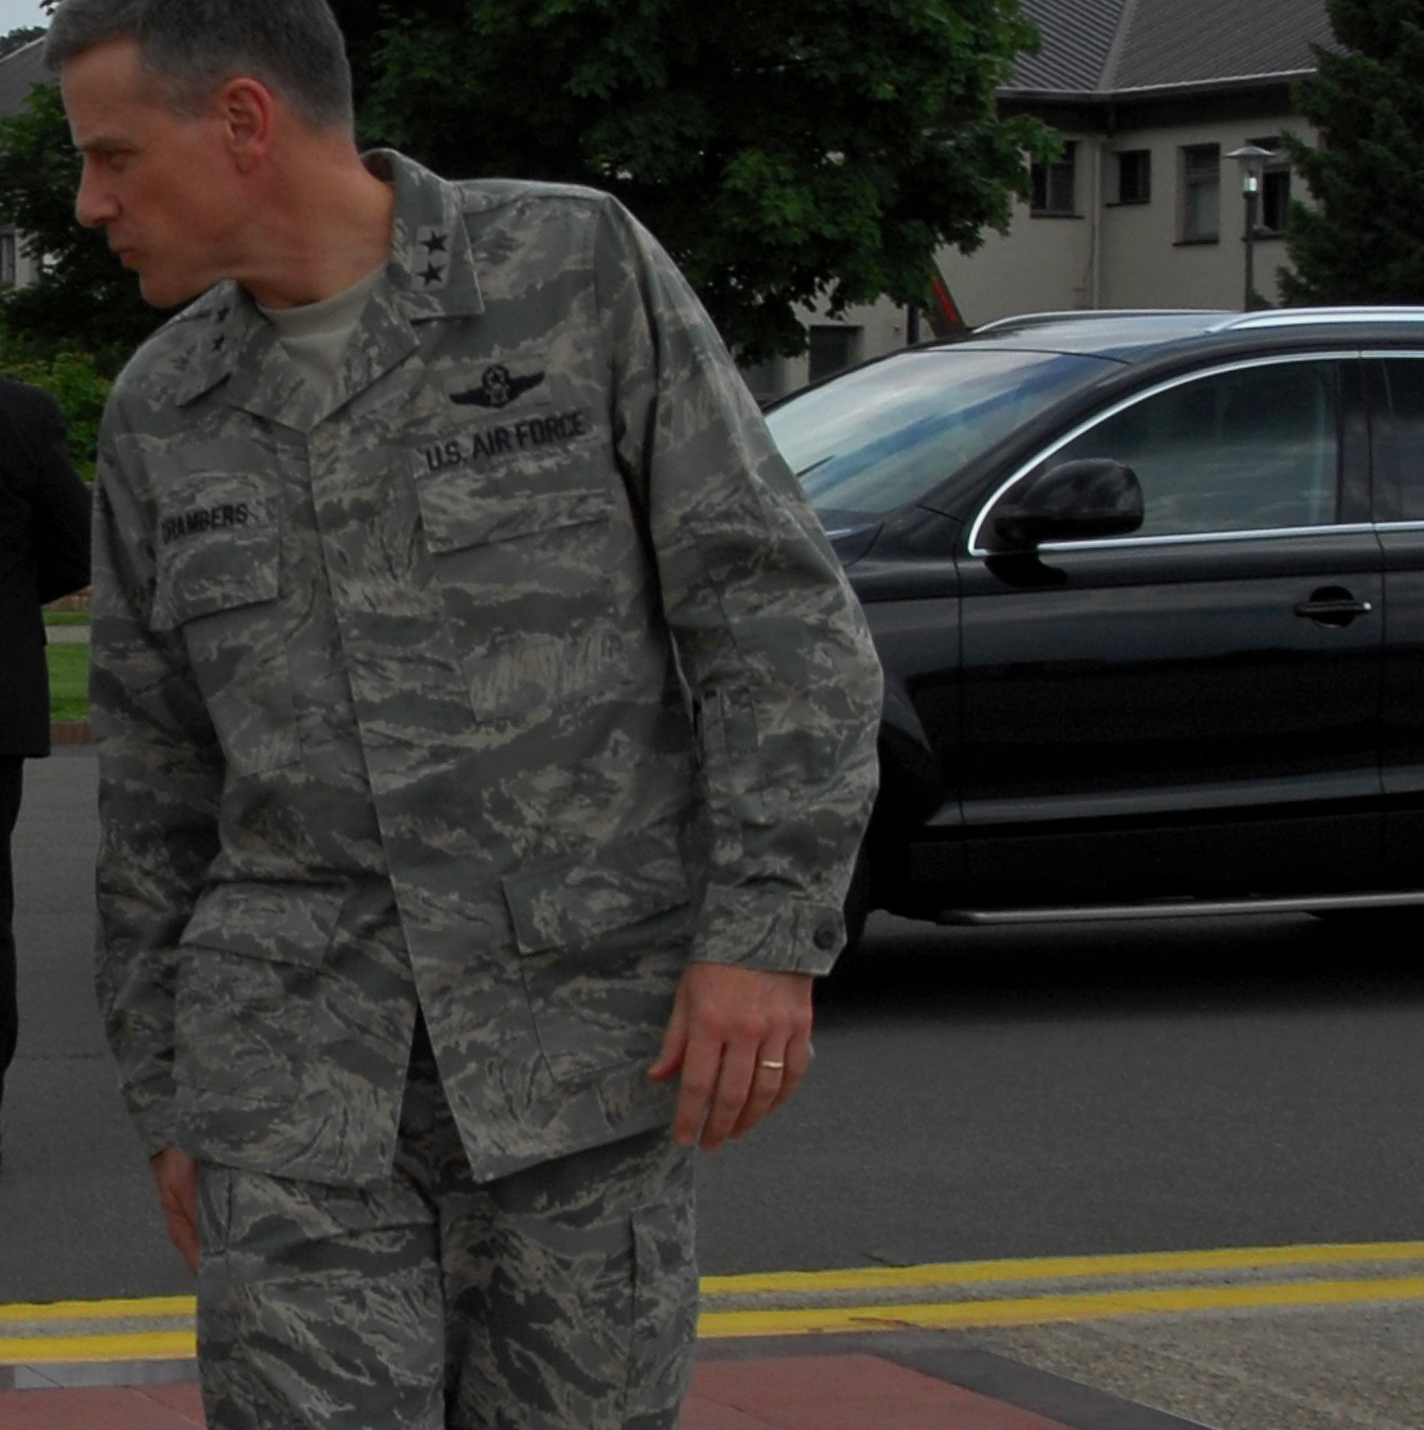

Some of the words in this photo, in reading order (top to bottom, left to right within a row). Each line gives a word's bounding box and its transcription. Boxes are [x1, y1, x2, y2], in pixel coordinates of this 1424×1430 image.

[426, 439, 468, 471] U.S.
[472, 425, 513, 460] AIR
[513, 410, 587, 448] FORCE
